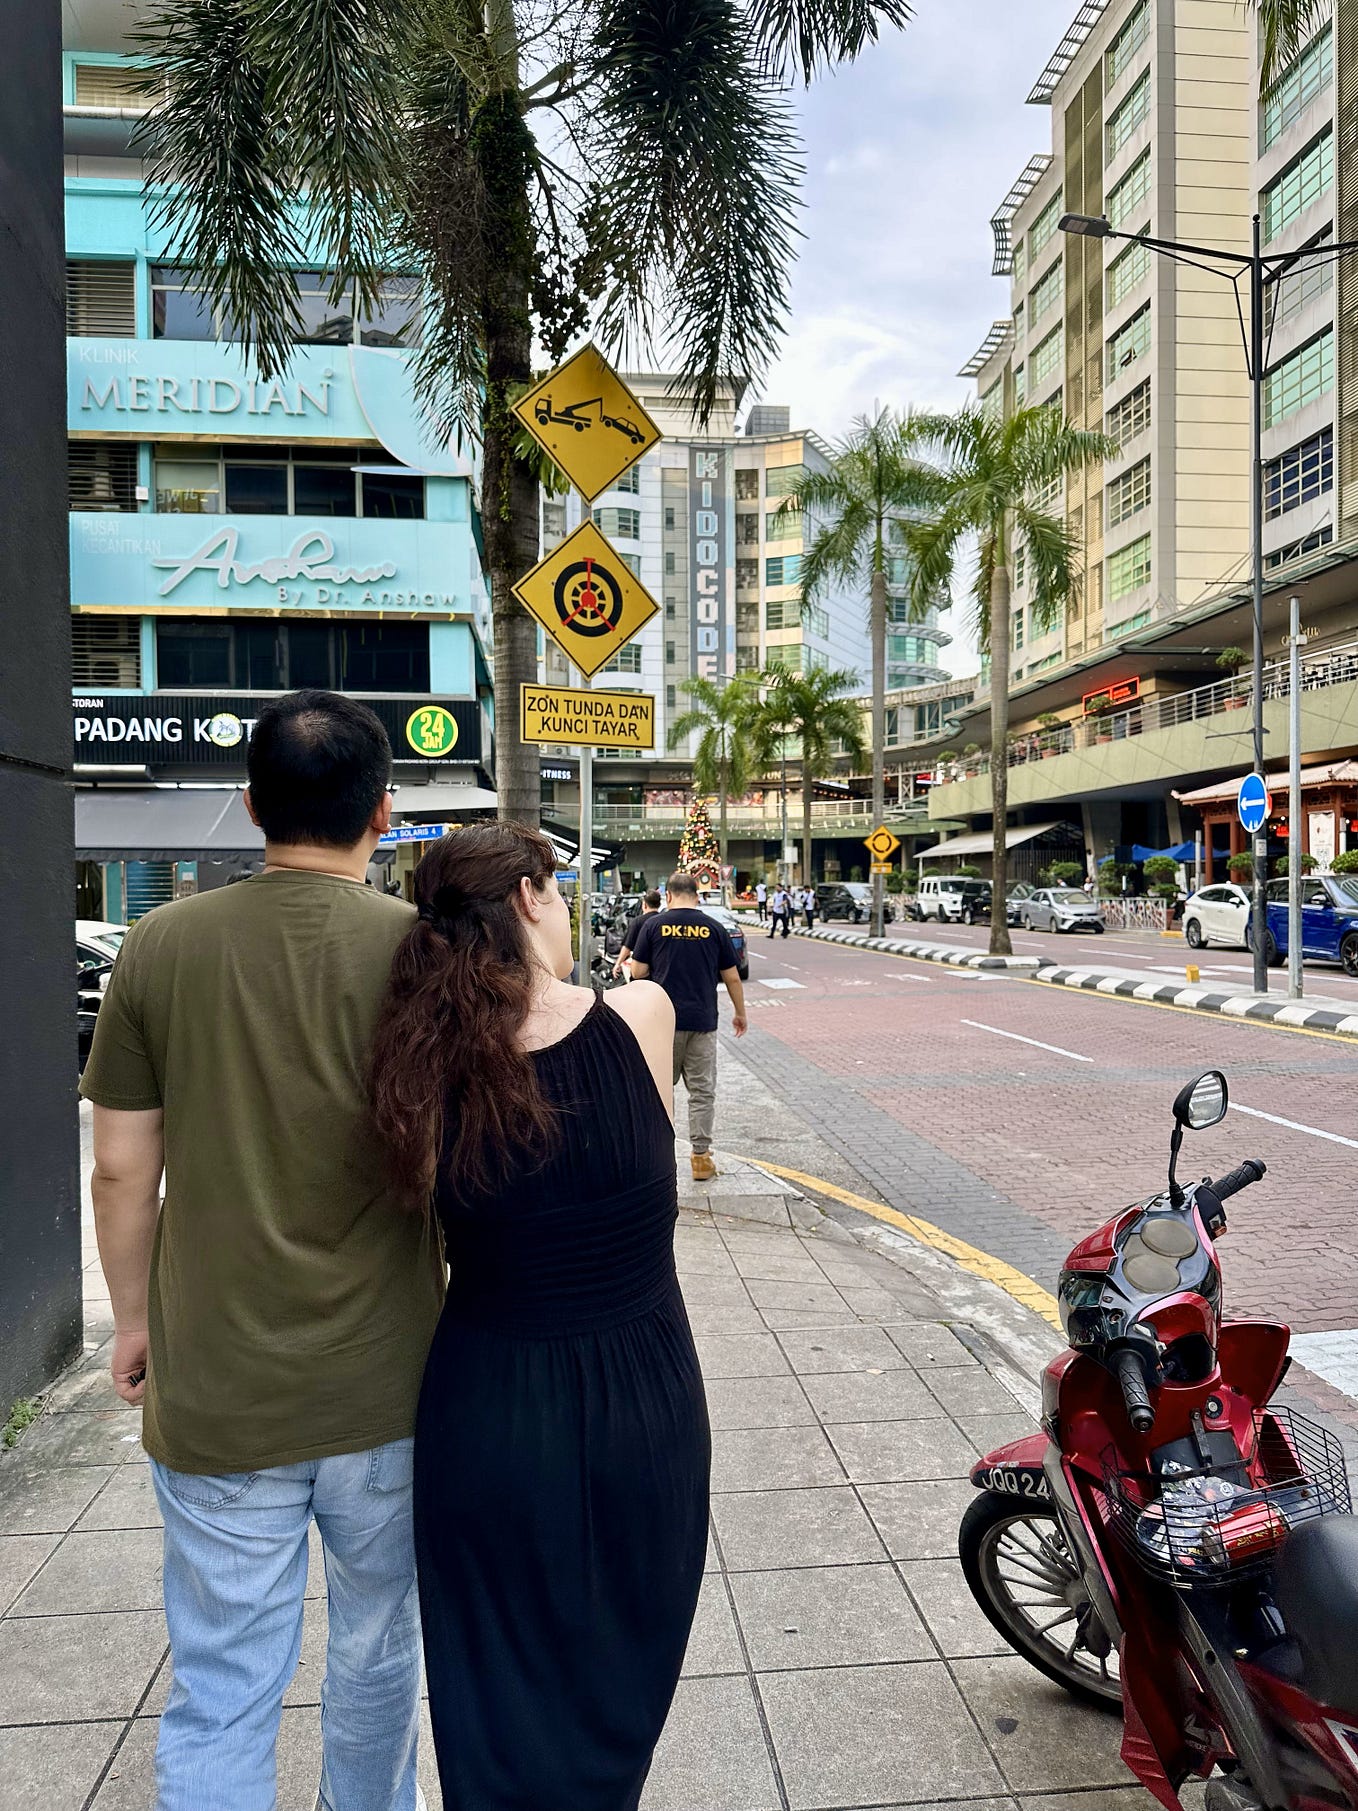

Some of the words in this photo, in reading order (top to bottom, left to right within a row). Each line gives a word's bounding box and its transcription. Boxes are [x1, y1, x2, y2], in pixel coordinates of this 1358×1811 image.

[79, 346, 139, 364] KLINIK
[81, 376, 332, 416] MERIDIAN
[82, 519, 120, 536] PUSAT
[695, 452, 719, 683] KIDOCODE
[278, 587, 304, 606] By
[316, 588, 350, 604] Dr.
[362, 590, 458, 607] Anshaw
[72, 699, 104, 708] TORAN
[527, 696, 559, 714] ZON
[564, 699, 615, 718] TUNDA
[619, 704, 649, 720] DAN
[74, 717, 183, 742] PADANG
[420, 712, 445, 738] 24
[541, 716, 588, 734] KUNCI
[592, 720, 638, 738] TAYAR
[540, 769, 572, 780] ITNESS
[400, 828, 429, 837] SOLARIS
[431, 827, 436, 835] 4
